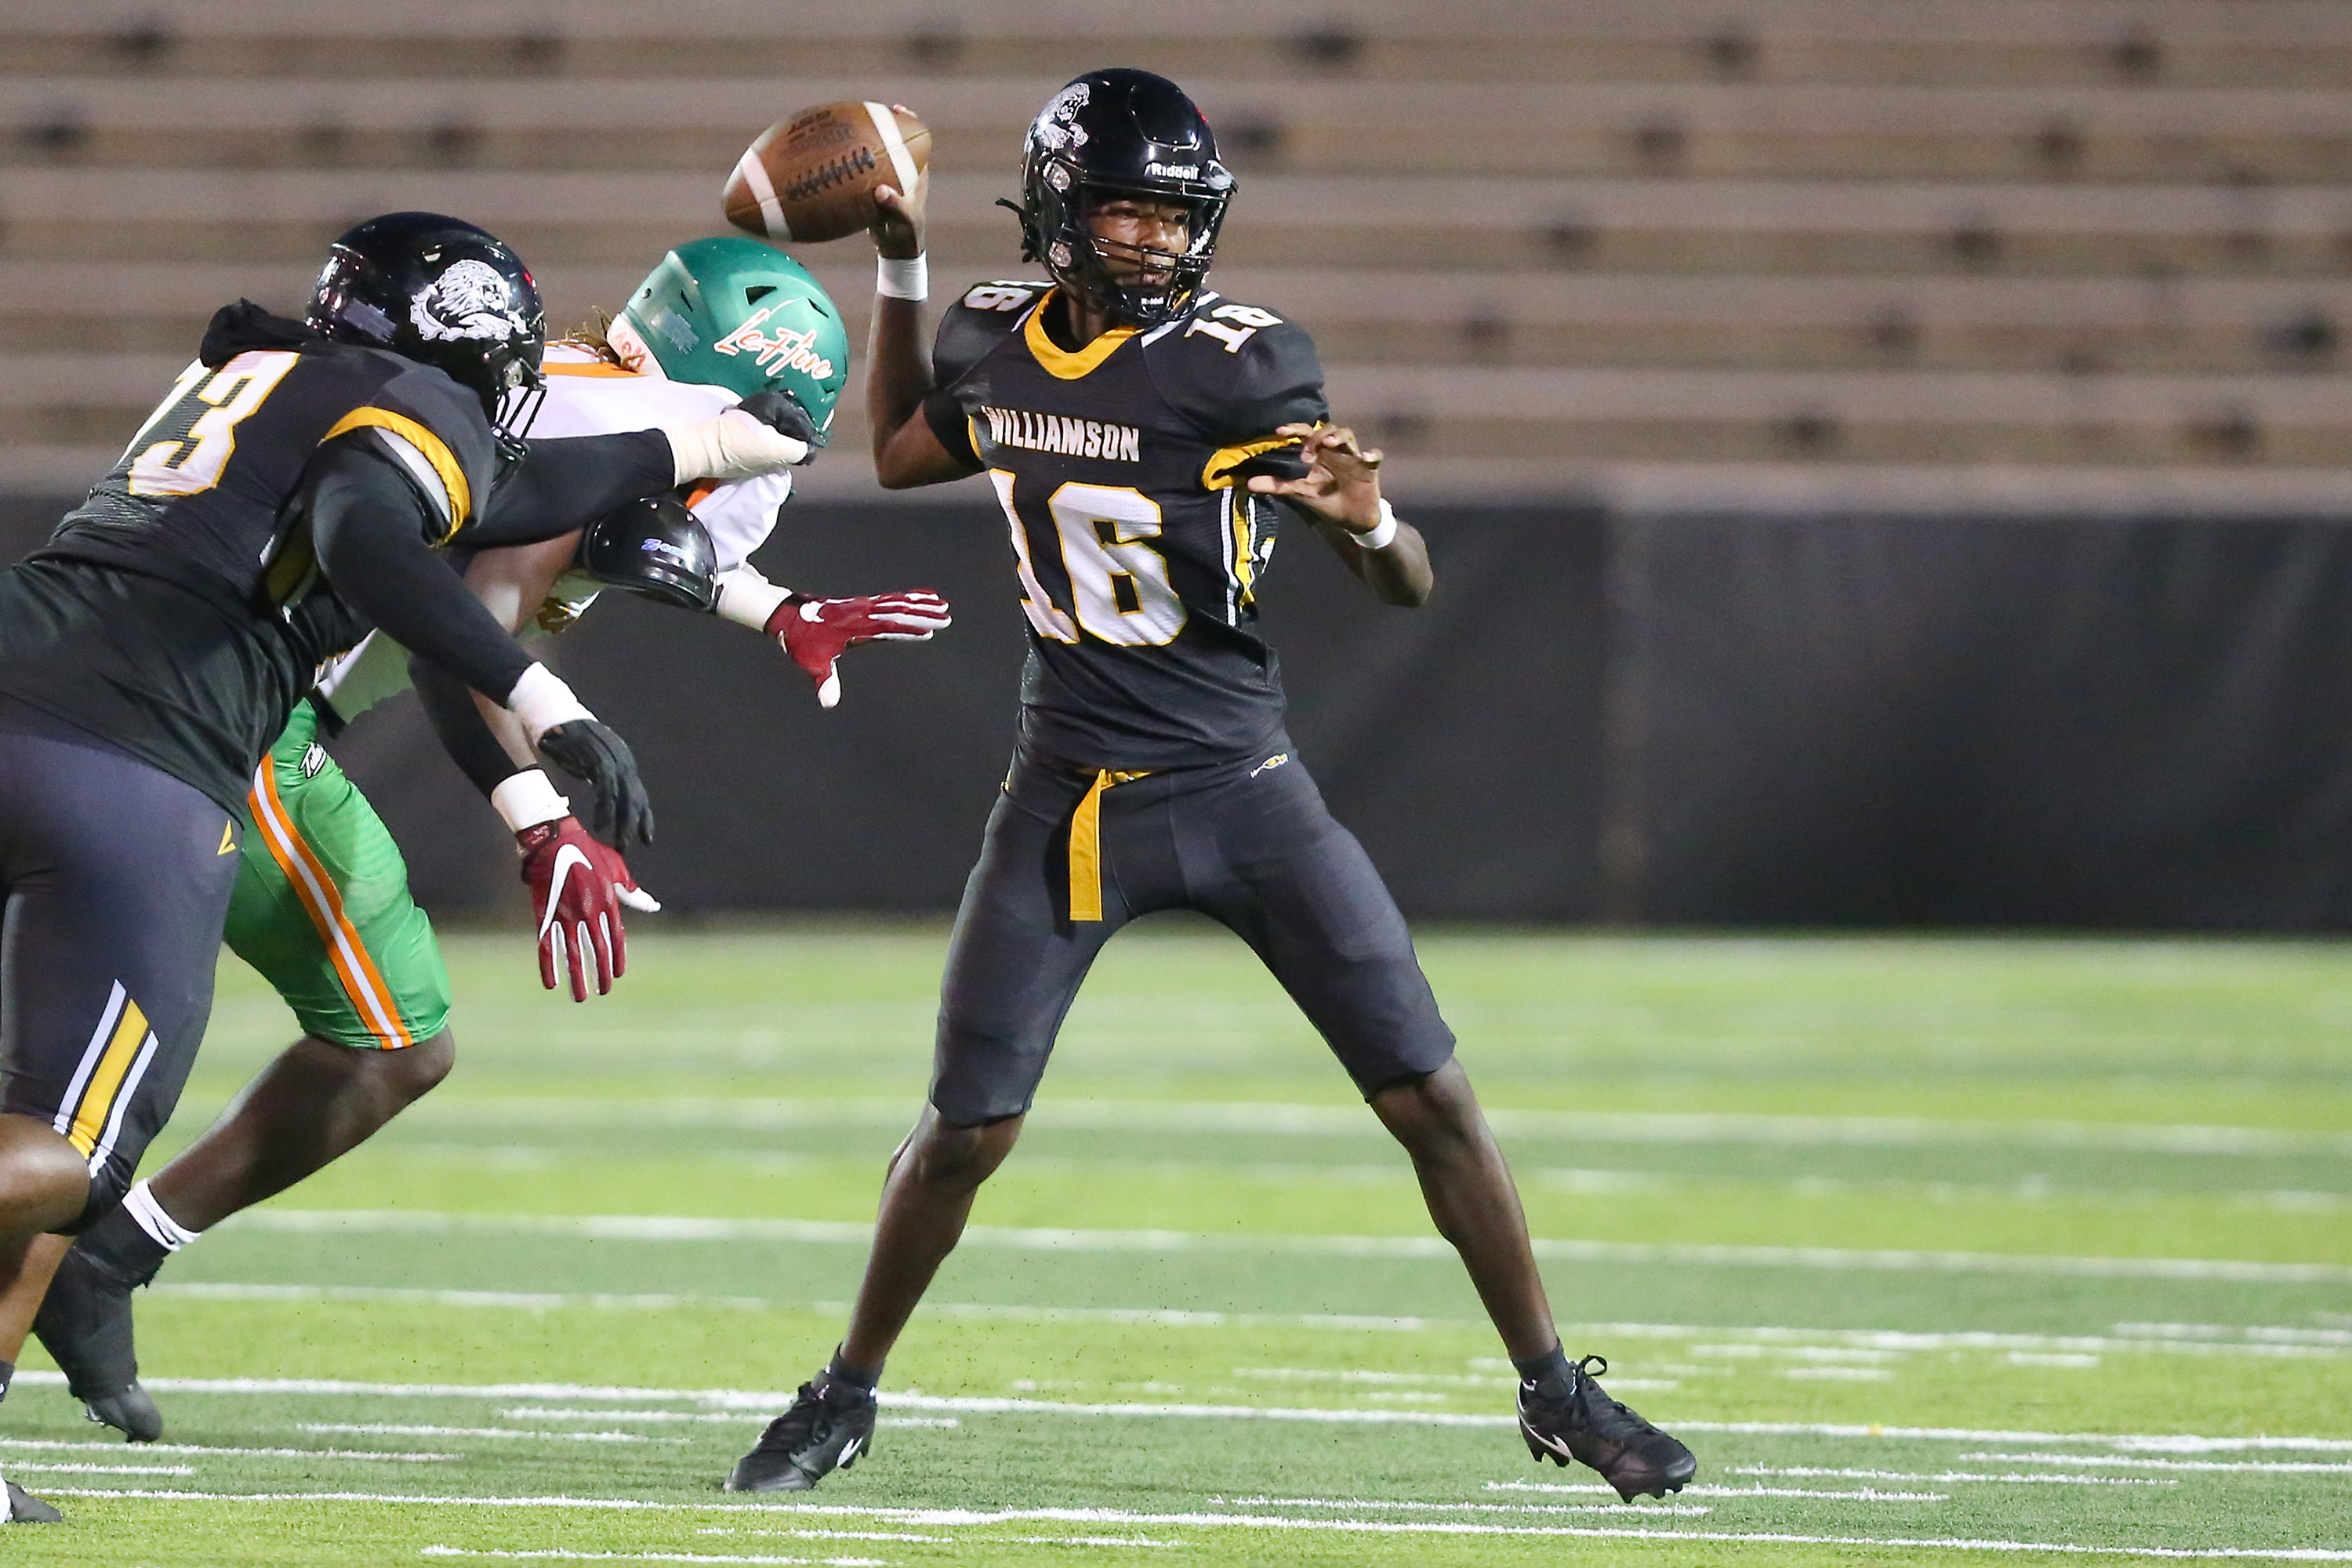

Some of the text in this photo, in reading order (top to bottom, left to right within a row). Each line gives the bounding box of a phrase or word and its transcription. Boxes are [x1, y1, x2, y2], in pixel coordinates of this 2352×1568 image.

[1151, 162, 1200, 180] Riddell
[1185, 227, 1210, 256] iddell
[1183, 304, 1283, 354] 16
[981, 405, 1140, 462] WILLIAMSON
[989, 468, 1188, 647] 16
